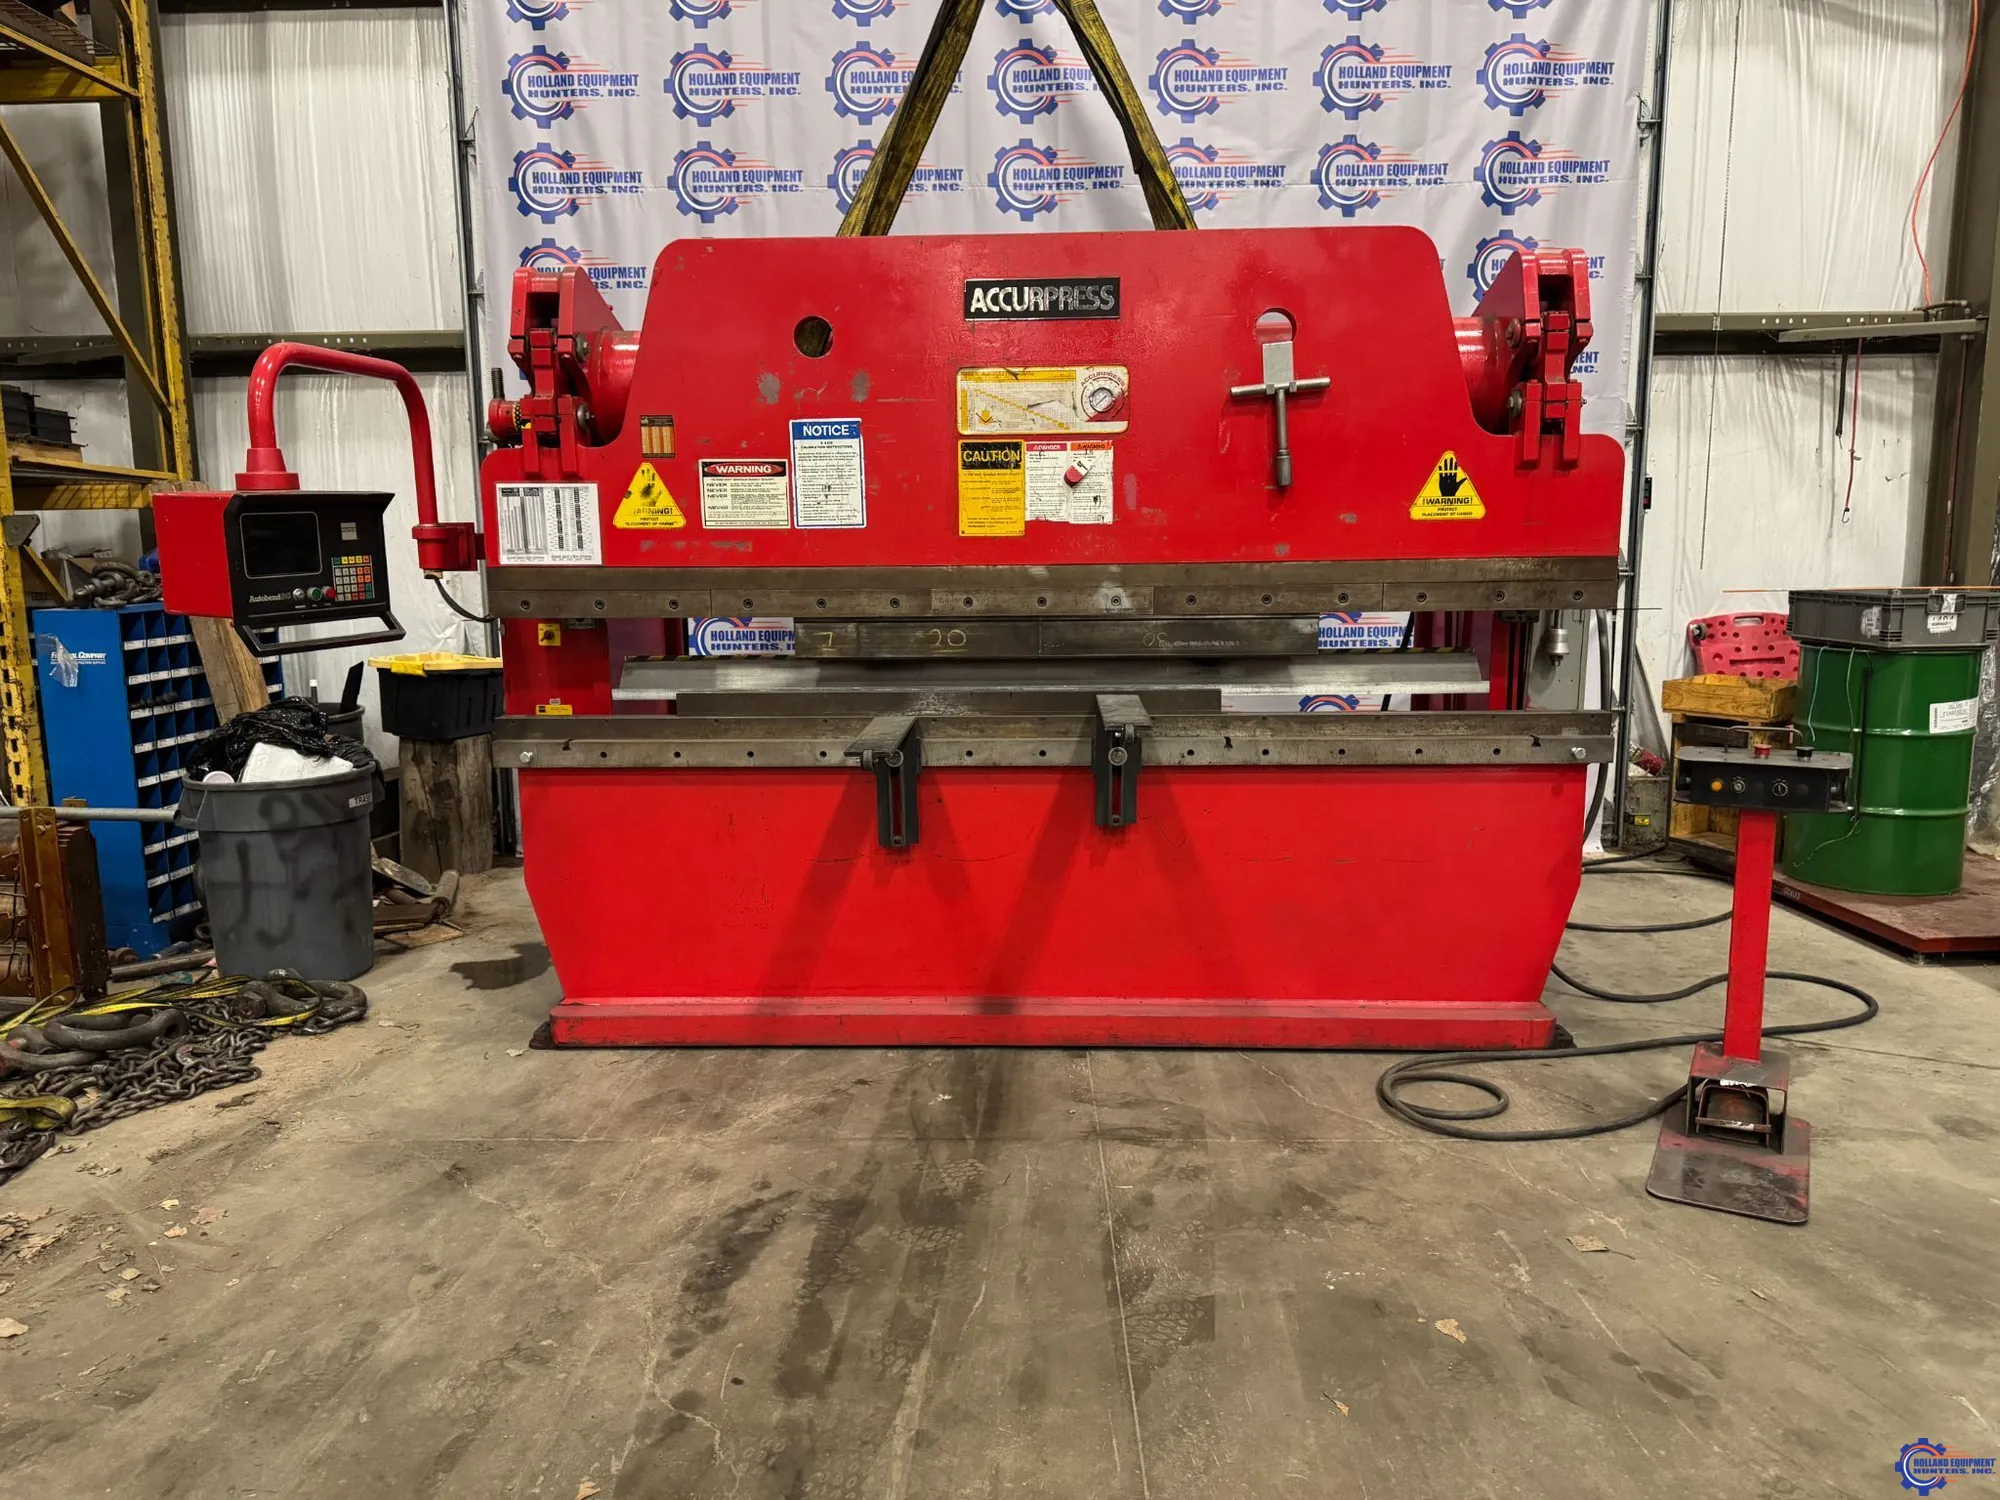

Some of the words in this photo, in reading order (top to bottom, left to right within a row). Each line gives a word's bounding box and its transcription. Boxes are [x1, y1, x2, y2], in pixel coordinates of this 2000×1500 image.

[1339, 65, 1388, 79] HOLLAND
[1389, 65, 1452, 79] EQUIPMENT
[1503, 62, 1551, 76] HOLLAND
[1552, 61, 1615, 75] EQUIPMENT
[528, 73, 575, 88] HOLLAND
[577, 73, 639, 88] EQUIPMENT
[688, 72, 737, 87] HOLLAND
[739, 72, 801, 86] EQUIPMENT
[850, 71, 898, 84] HOLLAND
[1013, 68, 1060, 83] HOLLAND
[1174, 69, 1223, 82] HOLLAND
[1225, 68, 1288, 81] EQUIPMENT
[1583, 76, 1614, 86] INC.
[1255, 82, 1288, 91] INC.
[1419, 79, 1452, 89] INC.
[607, 88, 641, 97] INC.
[769, 87, 801, 96] INC.
[1013, 168, 1060, 181] HOLLAND
[1062, 166, 1124, 180] EQUIPMENT
[1174, 166, 1222, 179] HOLLAND
[1224, 165, 1286, 178] EQUIPMENT
[1336, 163, 1384, 177] HOLLAND
[1386, 163, 1449, 176] EQUIPMENT
[1499, 160, 1545, 175] HOLLAND
[1547, 160, 1610, 174] EQUIPMENT
[532, 171, 579, 185] HOLLAND
[581, 170, 643, 185] EQUIPMENT
[692, 170, 739, 184] HOLLAND
[742, 169, 803, 183] EQUIPMENT
[1415, 176, 1448, 186] INC.
[1577, 174, 1610, 184] INC.
[611, 185, 644, 194] INC.
[771, 184, 803, 193] INC.
[932, 183, 964, 192] INC.
[1092, 180, 1124, 190] INC.
[1253, 180, 1285, 188] INC.
[588, 267, 647, 280] EQUIPMENT
[616, 281, 648, 289] INC.
[970, 285, 1115, 313] ACCURPRESS
[803, 425, 849, 436] NOTICE
[963, 450, 1020, 462] CAUTION
[715, 465, 772, 473] WARNING
[711, 630, 756, 641] HOLLAND
[1319, 626, 1364, 638] HOLLAND
